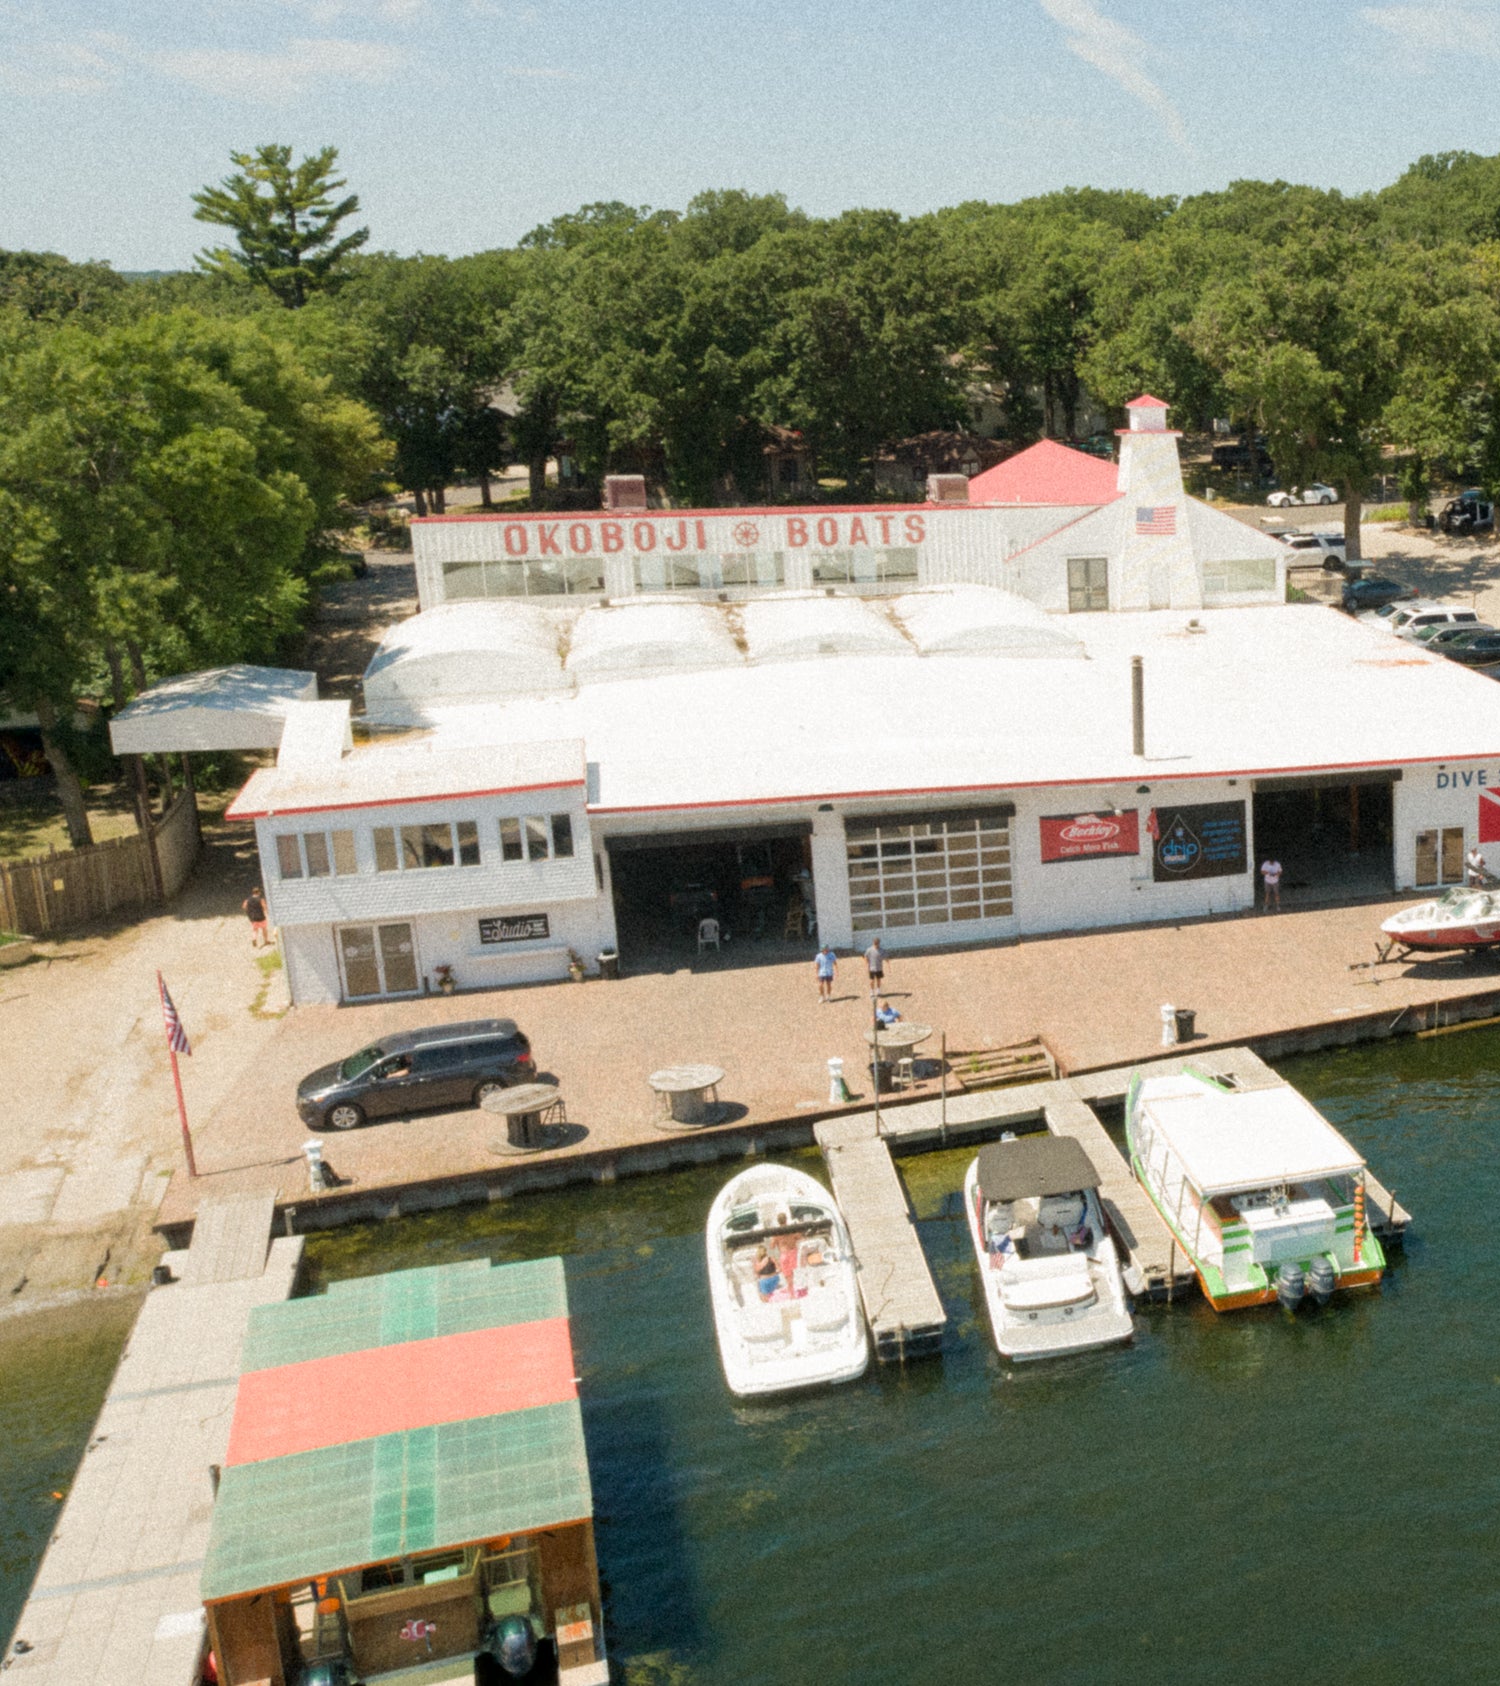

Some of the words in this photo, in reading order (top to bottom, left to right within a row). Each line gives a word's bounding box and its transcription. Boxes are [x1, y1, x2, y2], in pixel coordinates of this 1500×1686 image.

[503, 518, 708, 556] OKOBOJI
[787, 514, 927, 548] BOATS
[1437, 769, 1487, 789] DIVE
[1162, 838, 1198, 864] drip
[491, 920, 531, 941] Studio
